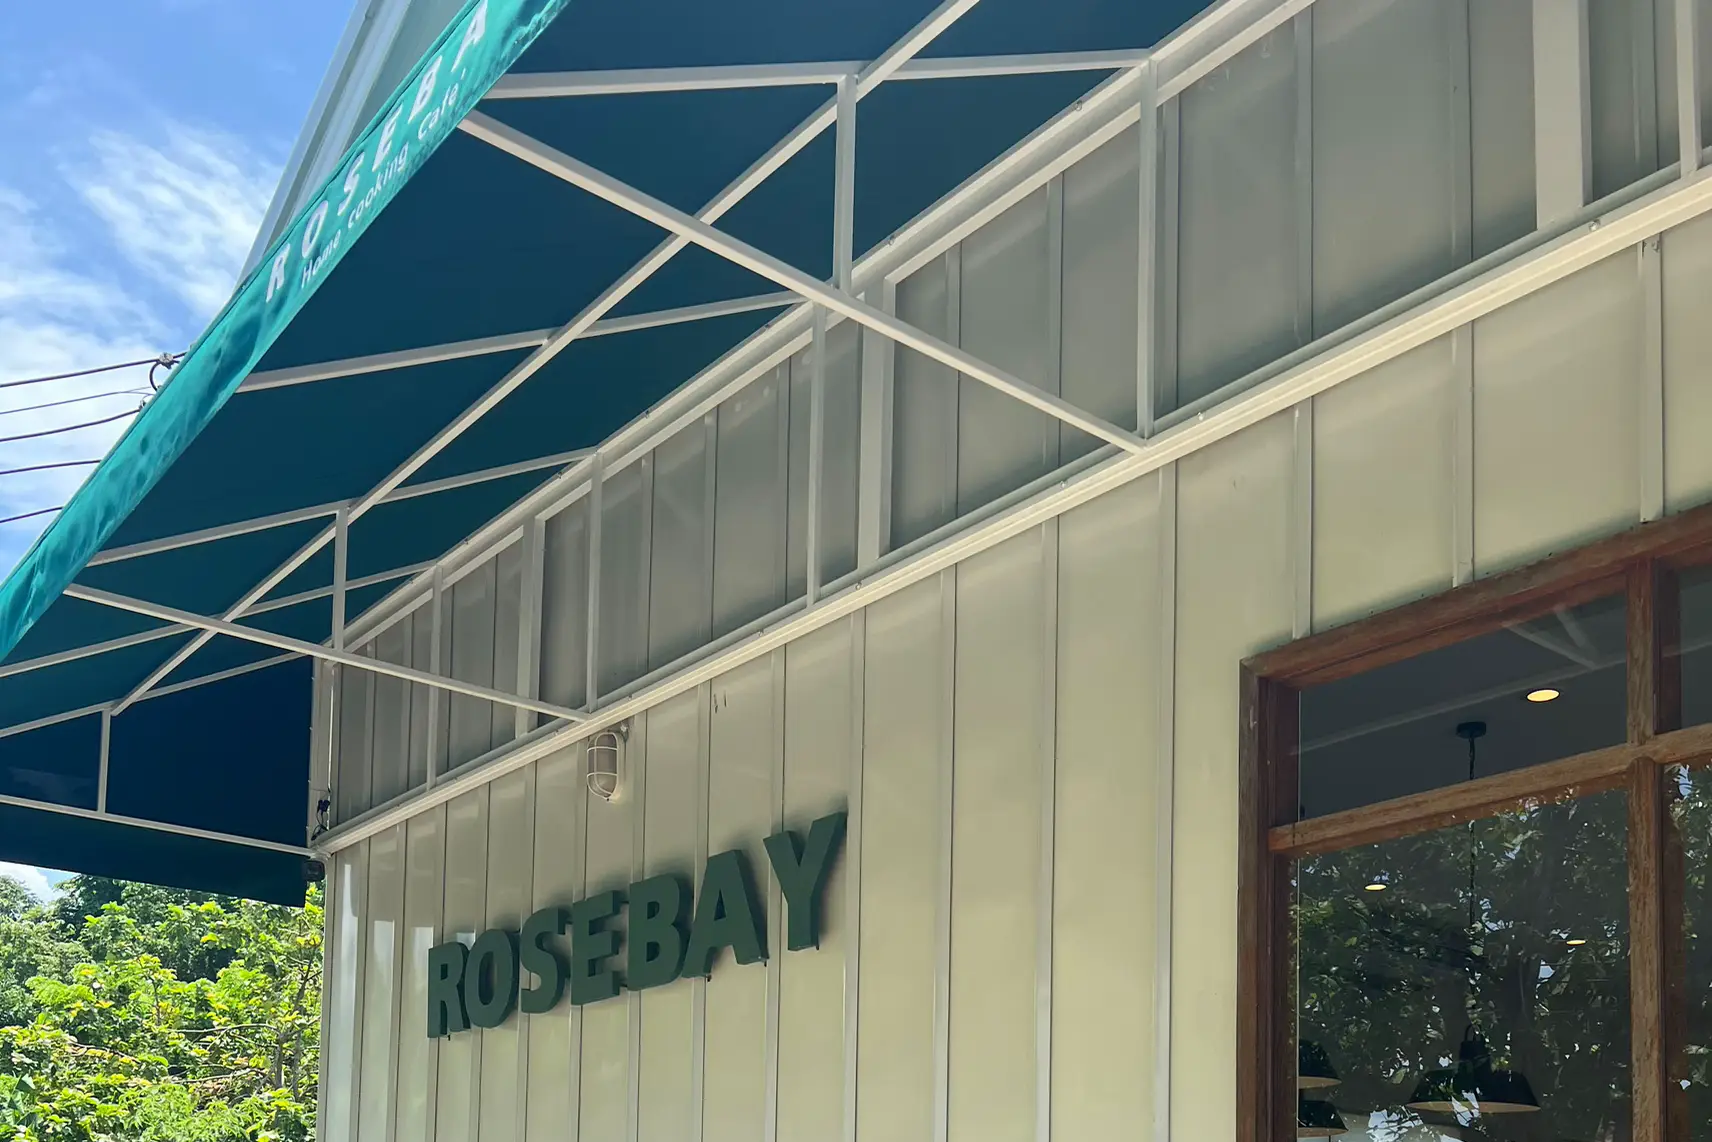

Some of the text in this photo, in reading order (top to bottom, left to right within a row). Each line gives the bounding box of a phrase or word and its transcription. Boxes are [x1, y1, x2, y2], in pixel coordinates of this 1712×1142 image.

[302, 229, 342, 290] Home
[348, 142, 409, 228] cooking
[428, 811, 848, 1038] ROSEBAY
